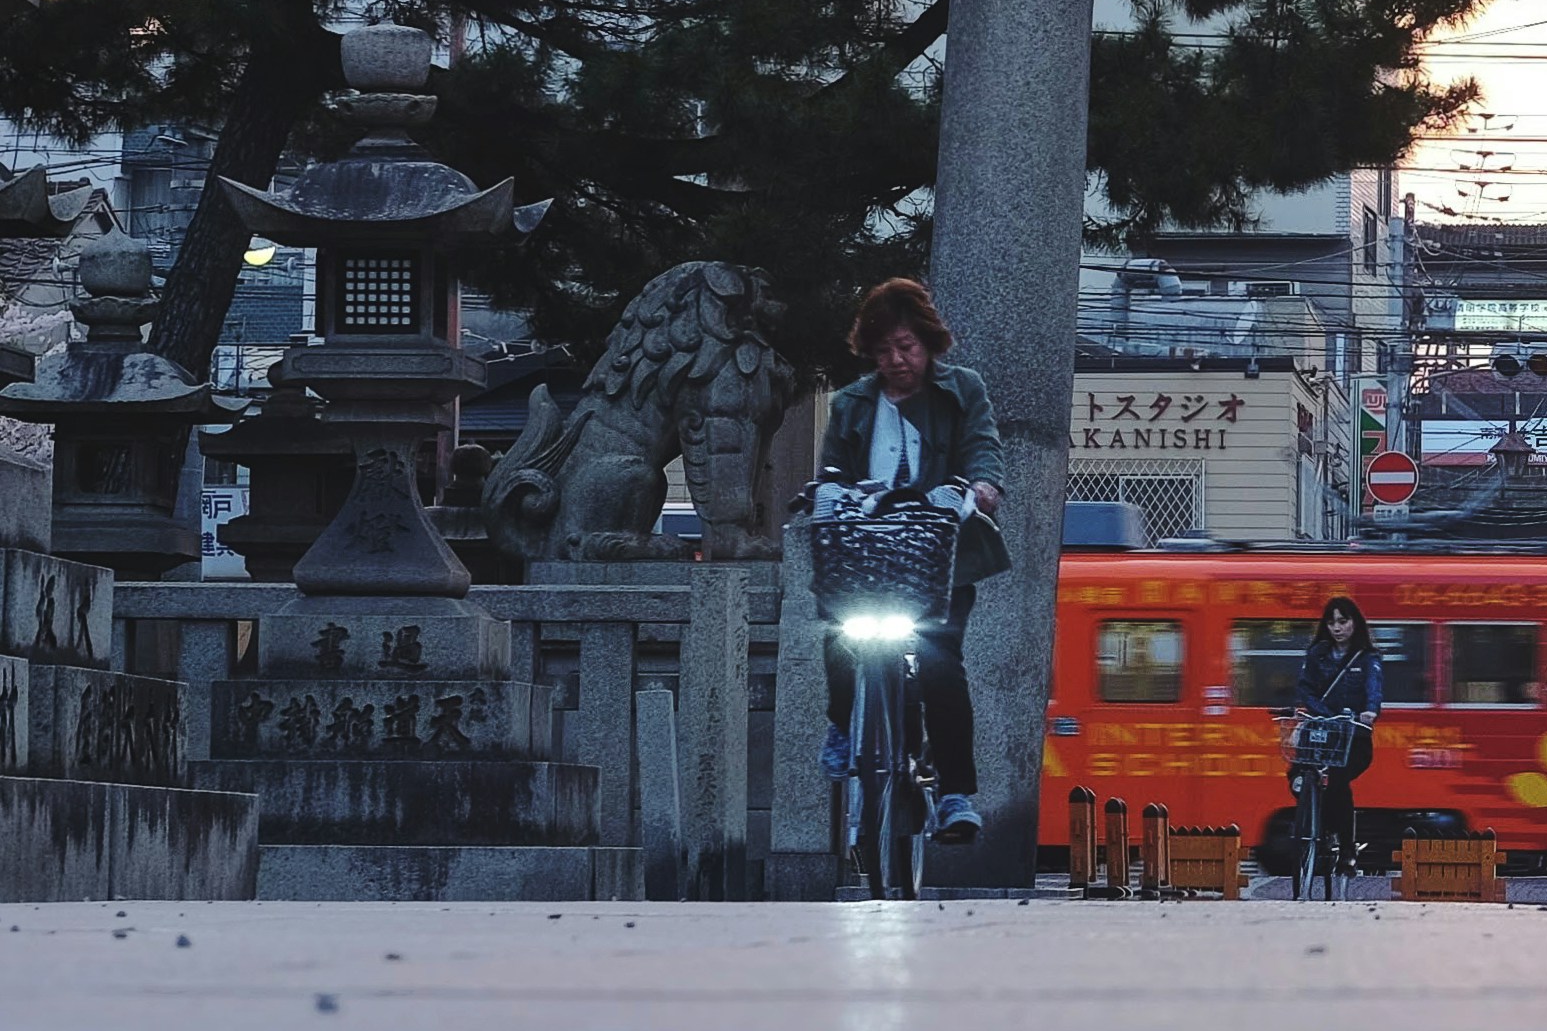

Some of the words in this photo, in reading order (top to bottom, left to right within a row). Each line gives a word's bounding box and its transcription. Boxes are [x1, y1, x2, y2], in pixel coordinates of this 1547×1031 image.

[1088, 392, 1246, 423] トスタジオ
